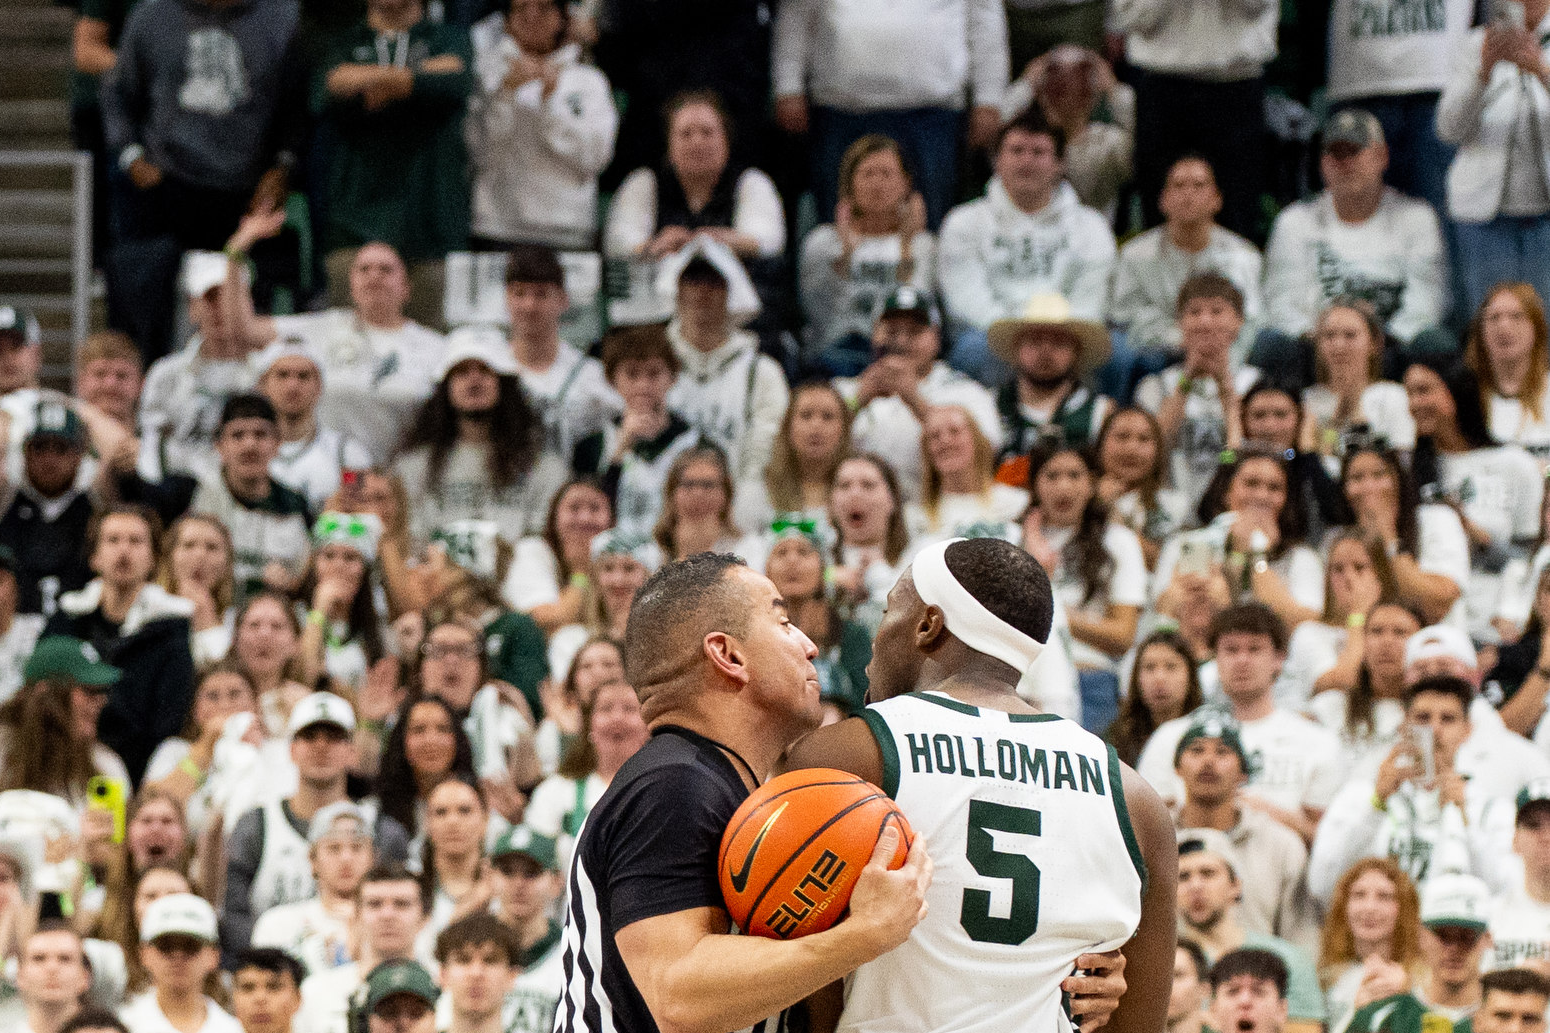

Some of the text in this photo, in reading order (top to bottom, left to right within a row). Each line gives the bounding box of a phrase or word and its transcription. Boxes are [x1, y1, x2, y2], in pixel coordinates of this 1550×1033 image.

[905, 732, 1105, 797] HOLLOMAN
[764, 848, 848, 938] ELITE
[960, 799, 1042, 946] 5
